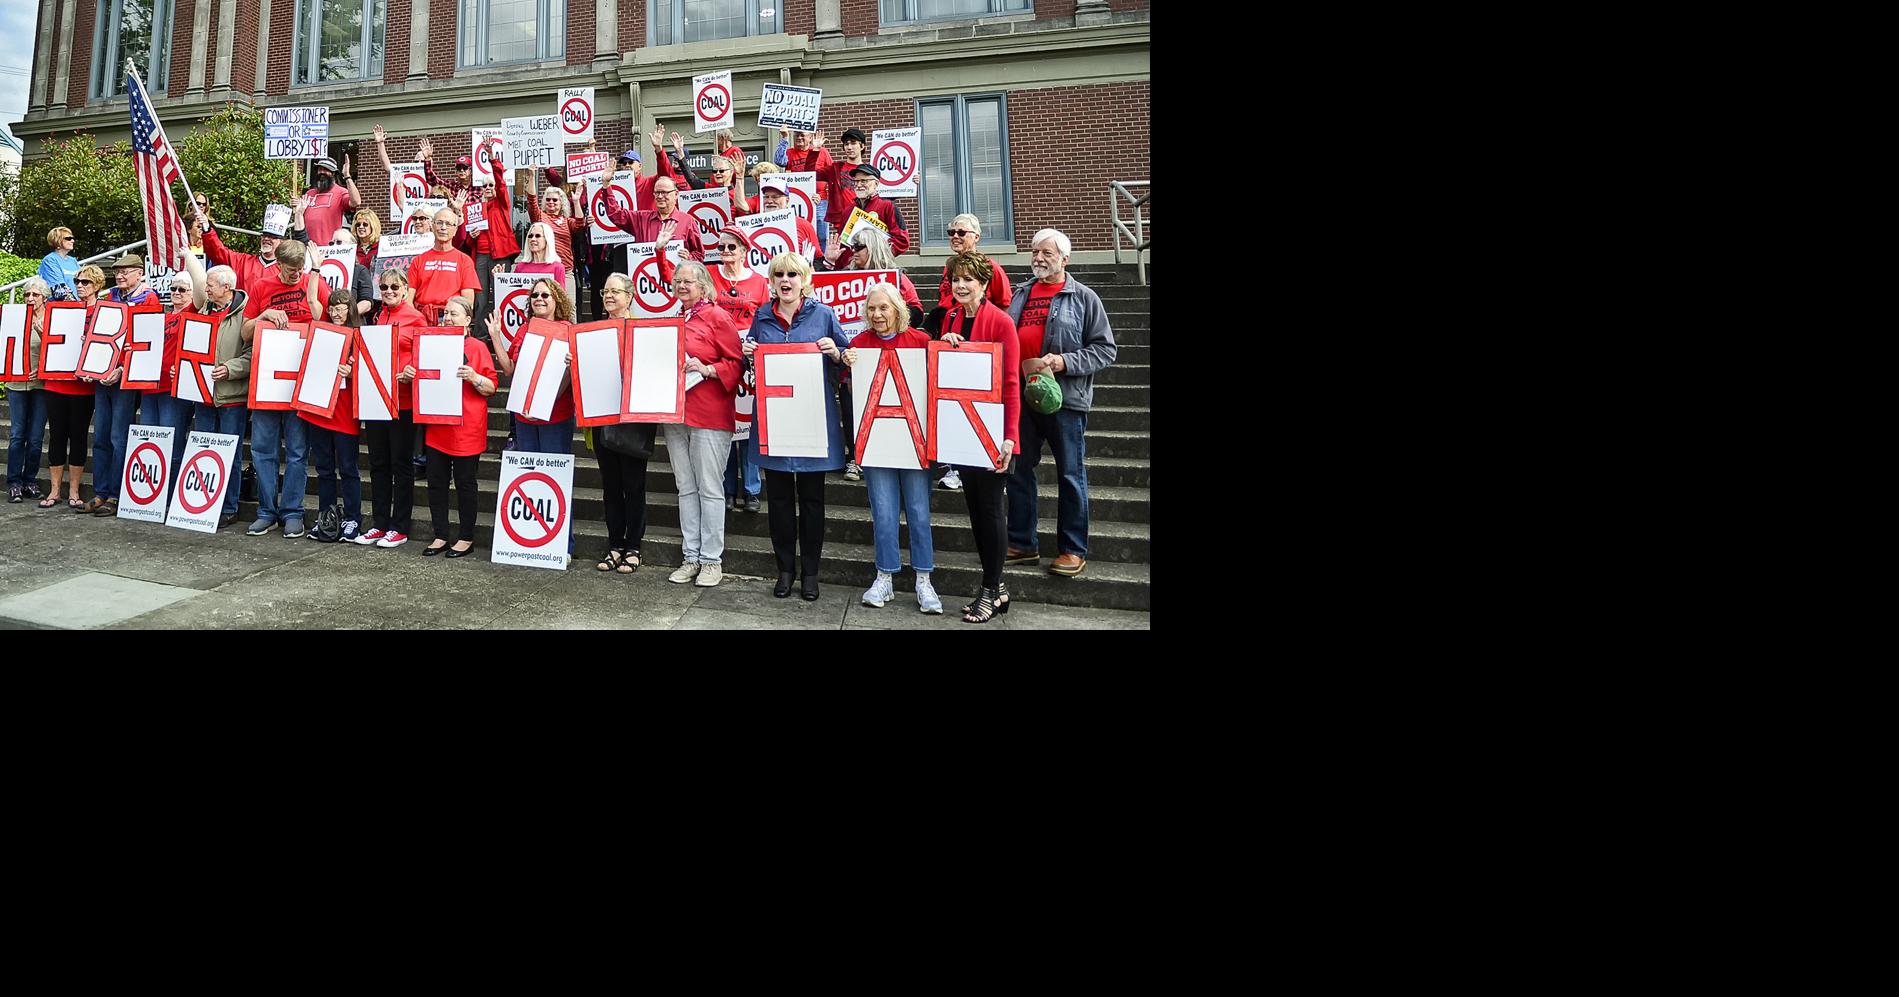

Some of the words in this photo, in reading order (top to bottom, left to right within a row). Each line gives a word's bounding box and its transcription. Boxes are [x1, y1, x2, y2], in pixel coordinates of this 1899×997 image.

[564, 89, 586, 98] RALLY
[766, 90, 784, 104] NO
[785, 93, 816, 109] COAL
[701, 95, 725, 110] COAL
[266, 107, 327, 125] COMMISSIONER
[564, 110, 587, 123] COAL
[763, 104, 815, 121] EXPORTS
[529, 116, 559, 130] WEBER
[288, 125, 301, 139] OR
[527, 137, 548, 148] COAL
[513, 147, 555, 167] PUPPET
[568, 158, 582, 169] NO
[582, 153, 607, 166] COAL
[879, 156, 908, 171] COAL
[794, 174, 813, 183] better"
[405, 186, 424, 199] OAL
[690, 192, 701, 200] CAN
[701, 191, 708, 199] do
[708, 190, 726, 199] better"
[467, 203, 483, 214] NO
[738, 219, 750, 227] "We
[750, 216, 763, 225] CAN
[763, 215, 771, 223] do
[771, 211, 792, 222] better"
[630, 246, 641, 254] "We
[641, 245, 653, 254] CAN
[497, 276, 509, 285] "We
[509, 276, 522, 285] CAN
[522, 276, 530, 285] do
[522, 317, 686, 428] TOO
[753, 340, 1005, 470] FAR
[139, 429, 149, 437] CAN
[149, 430, 155, 438] do
[155, 431, 171, 439] better"
[190, 435, 199, 443] "We
[199, 436, 210, 445] CAN
[210, 437, 217, 445] do
[216, 438, 235, 447] better"
[505, 455, 519, 465] "We
[520, 457, 535, 466] CAN
[535, 459, 545, 467] do
[546, 458, 570, 468] better"
[131, 462, 159, 485] COAL
[185, 470, 216, 494] COAL
[510, 496, 555, 523] COAL
